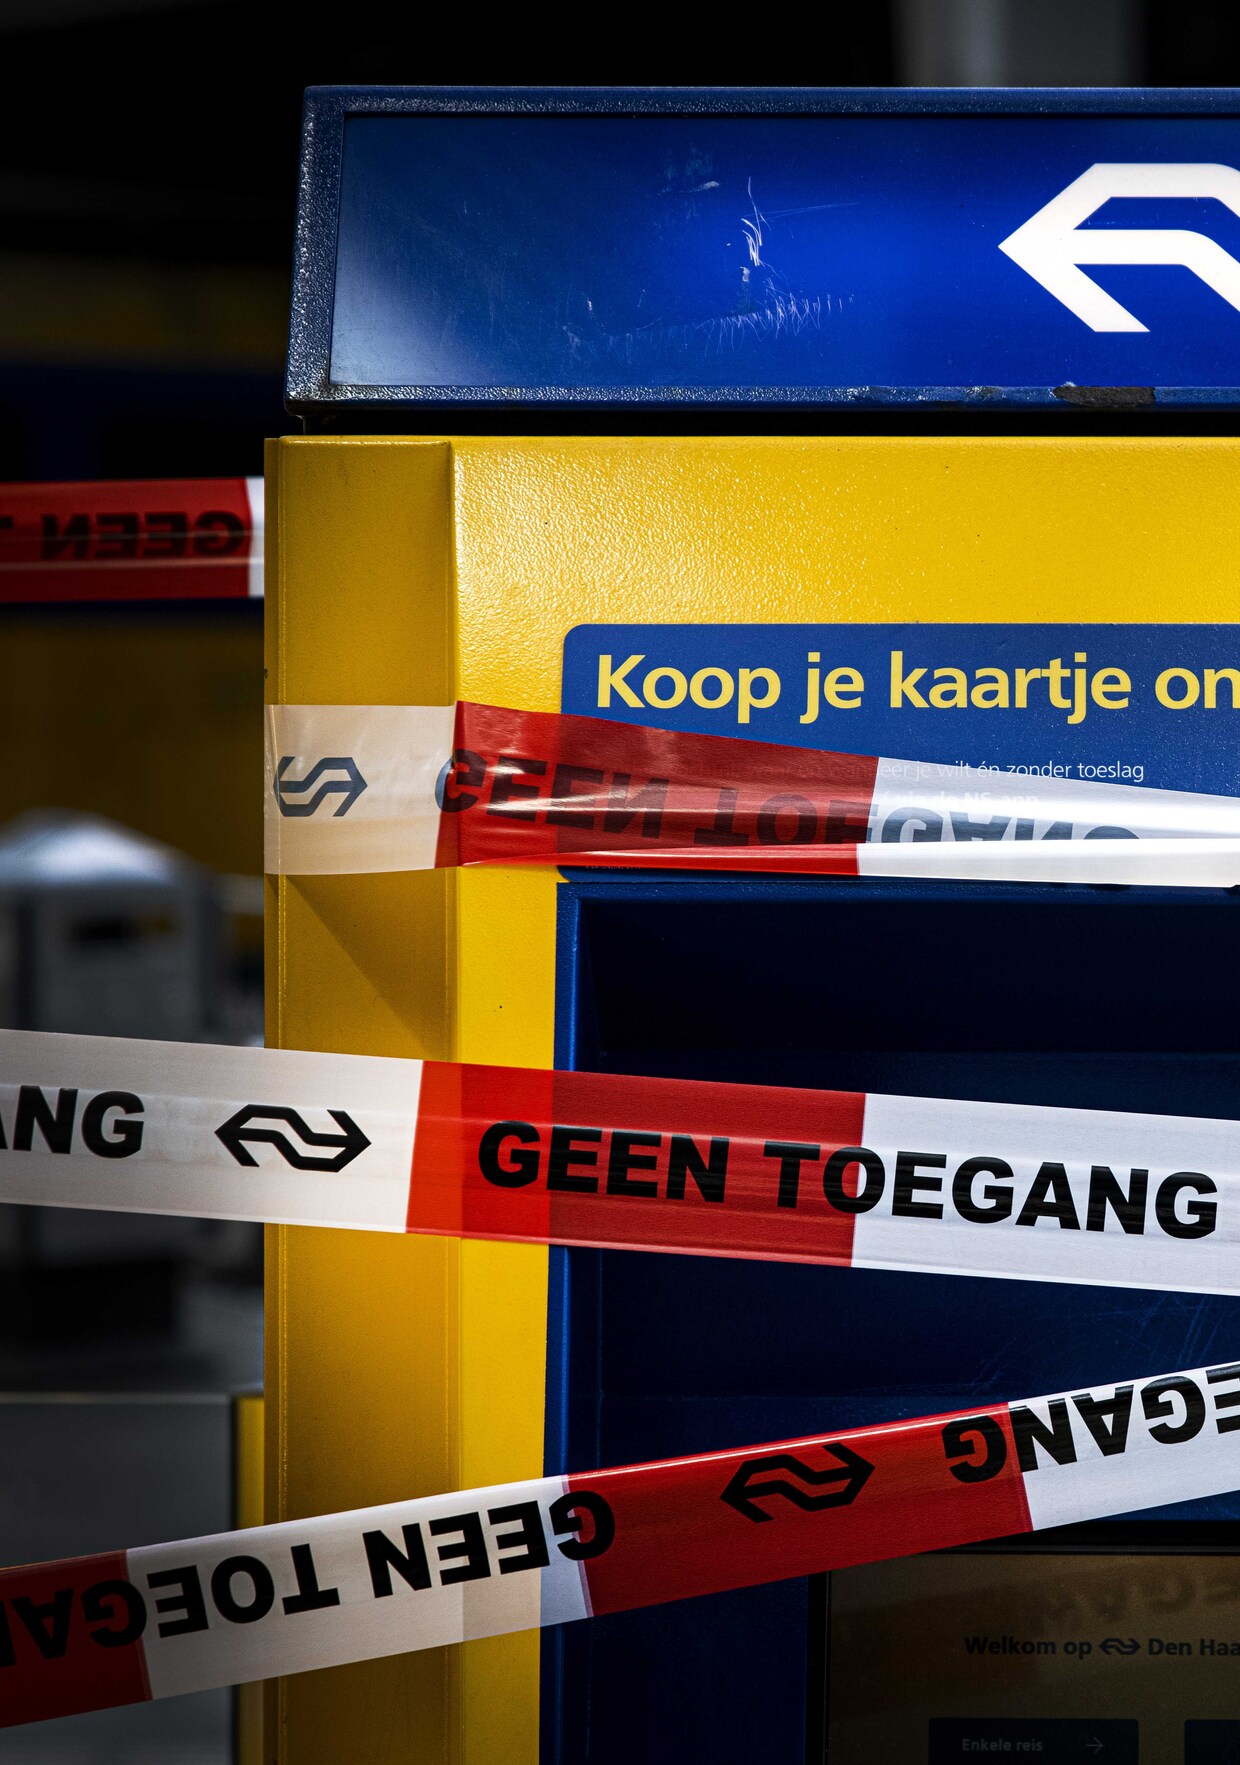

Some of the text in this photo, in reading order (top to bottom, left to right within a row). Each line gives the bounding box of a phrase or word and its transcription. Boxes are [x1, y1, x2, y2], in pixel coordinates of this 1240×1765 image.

[597, 654, 781, 724] Koop
[800, 652, 864, 724] je
[891, 651, 1131, 725] kaartje
[915, 761, 931, 782] je
[937, 761, 971, 778] wilt
[977, 761, 1000, 778] én
[1006, 761, 1069, 778] zonder
[1078, 761, 1144, 782] toeslag
[0, 1084, 144, 1158] NG
[478, 1120, 1218, 1239] GEEN TOEGANG
[363, 1490, 615, 1599] GEEN
[964, 1636, 1057, 1656] Welkom
[1064, 1640, 1092, 1662] op
[1148, 1637, 1192, 1656] Den
[961, 1736, 1043, 1753] Enkele reis
